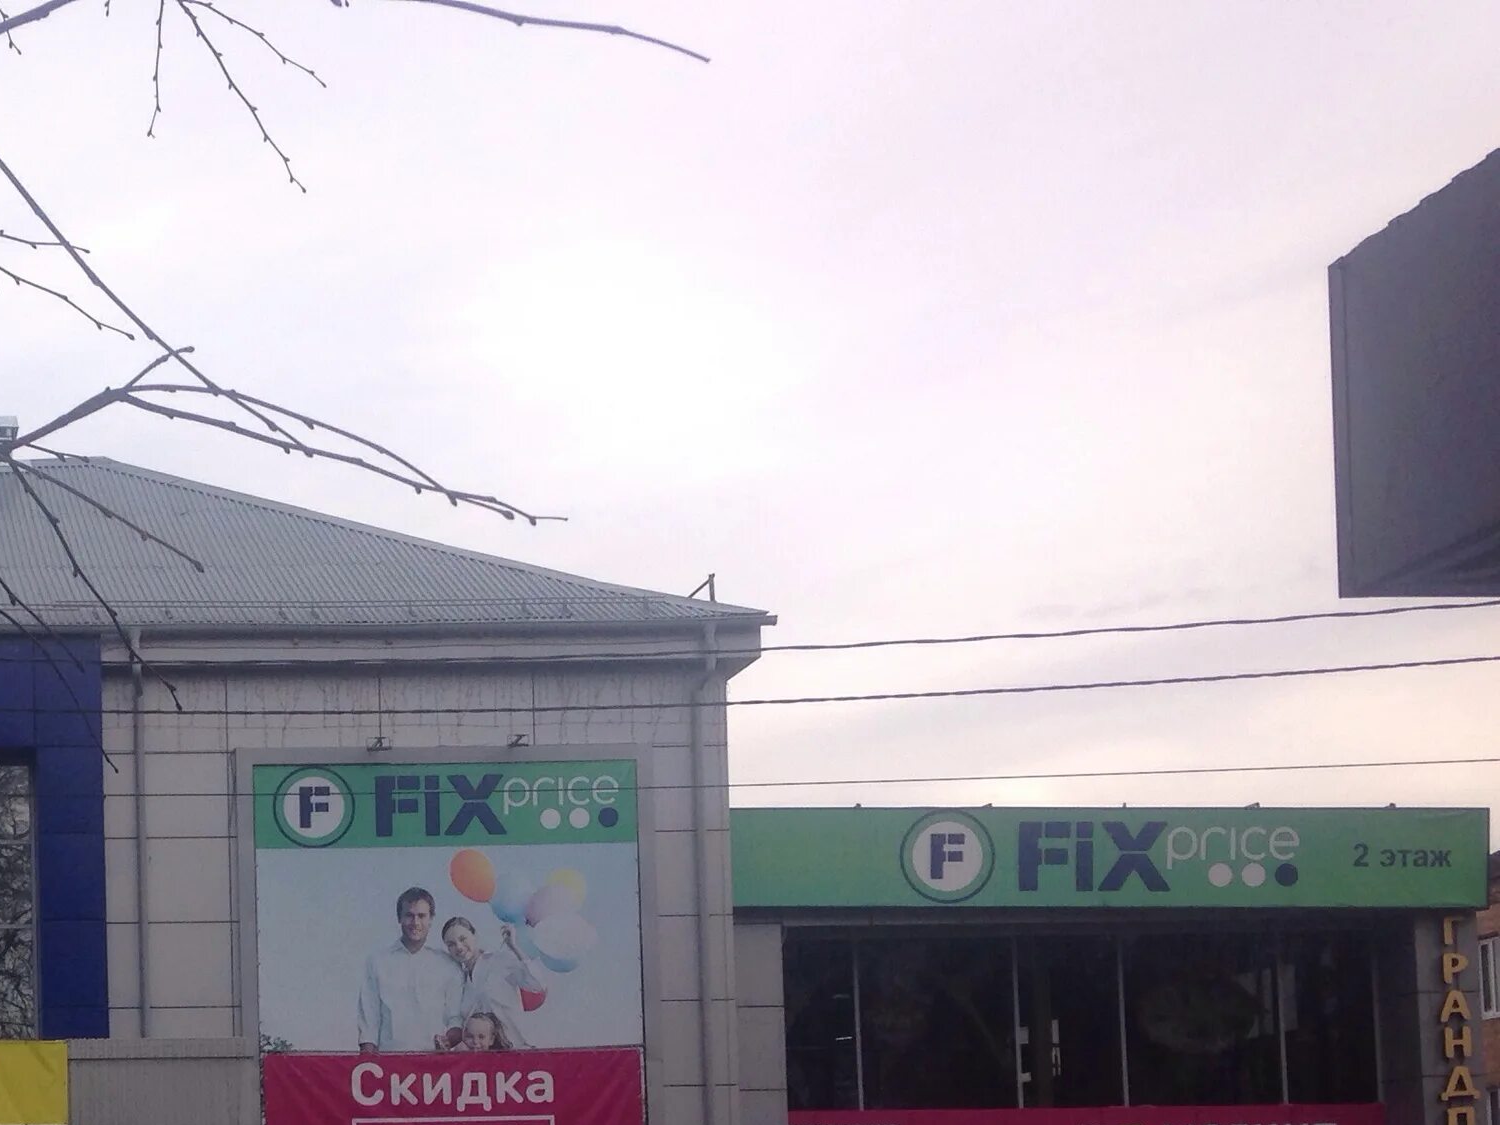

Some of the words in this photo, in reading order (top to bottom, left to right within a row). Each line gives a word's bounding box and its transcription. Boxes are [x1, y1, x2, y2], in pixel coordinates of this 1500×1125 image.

[1352, 843, 1370, 868] 2
[1379, 846, 1453, 869] этаж
[350, 1062, 555, 1111] Скидка
